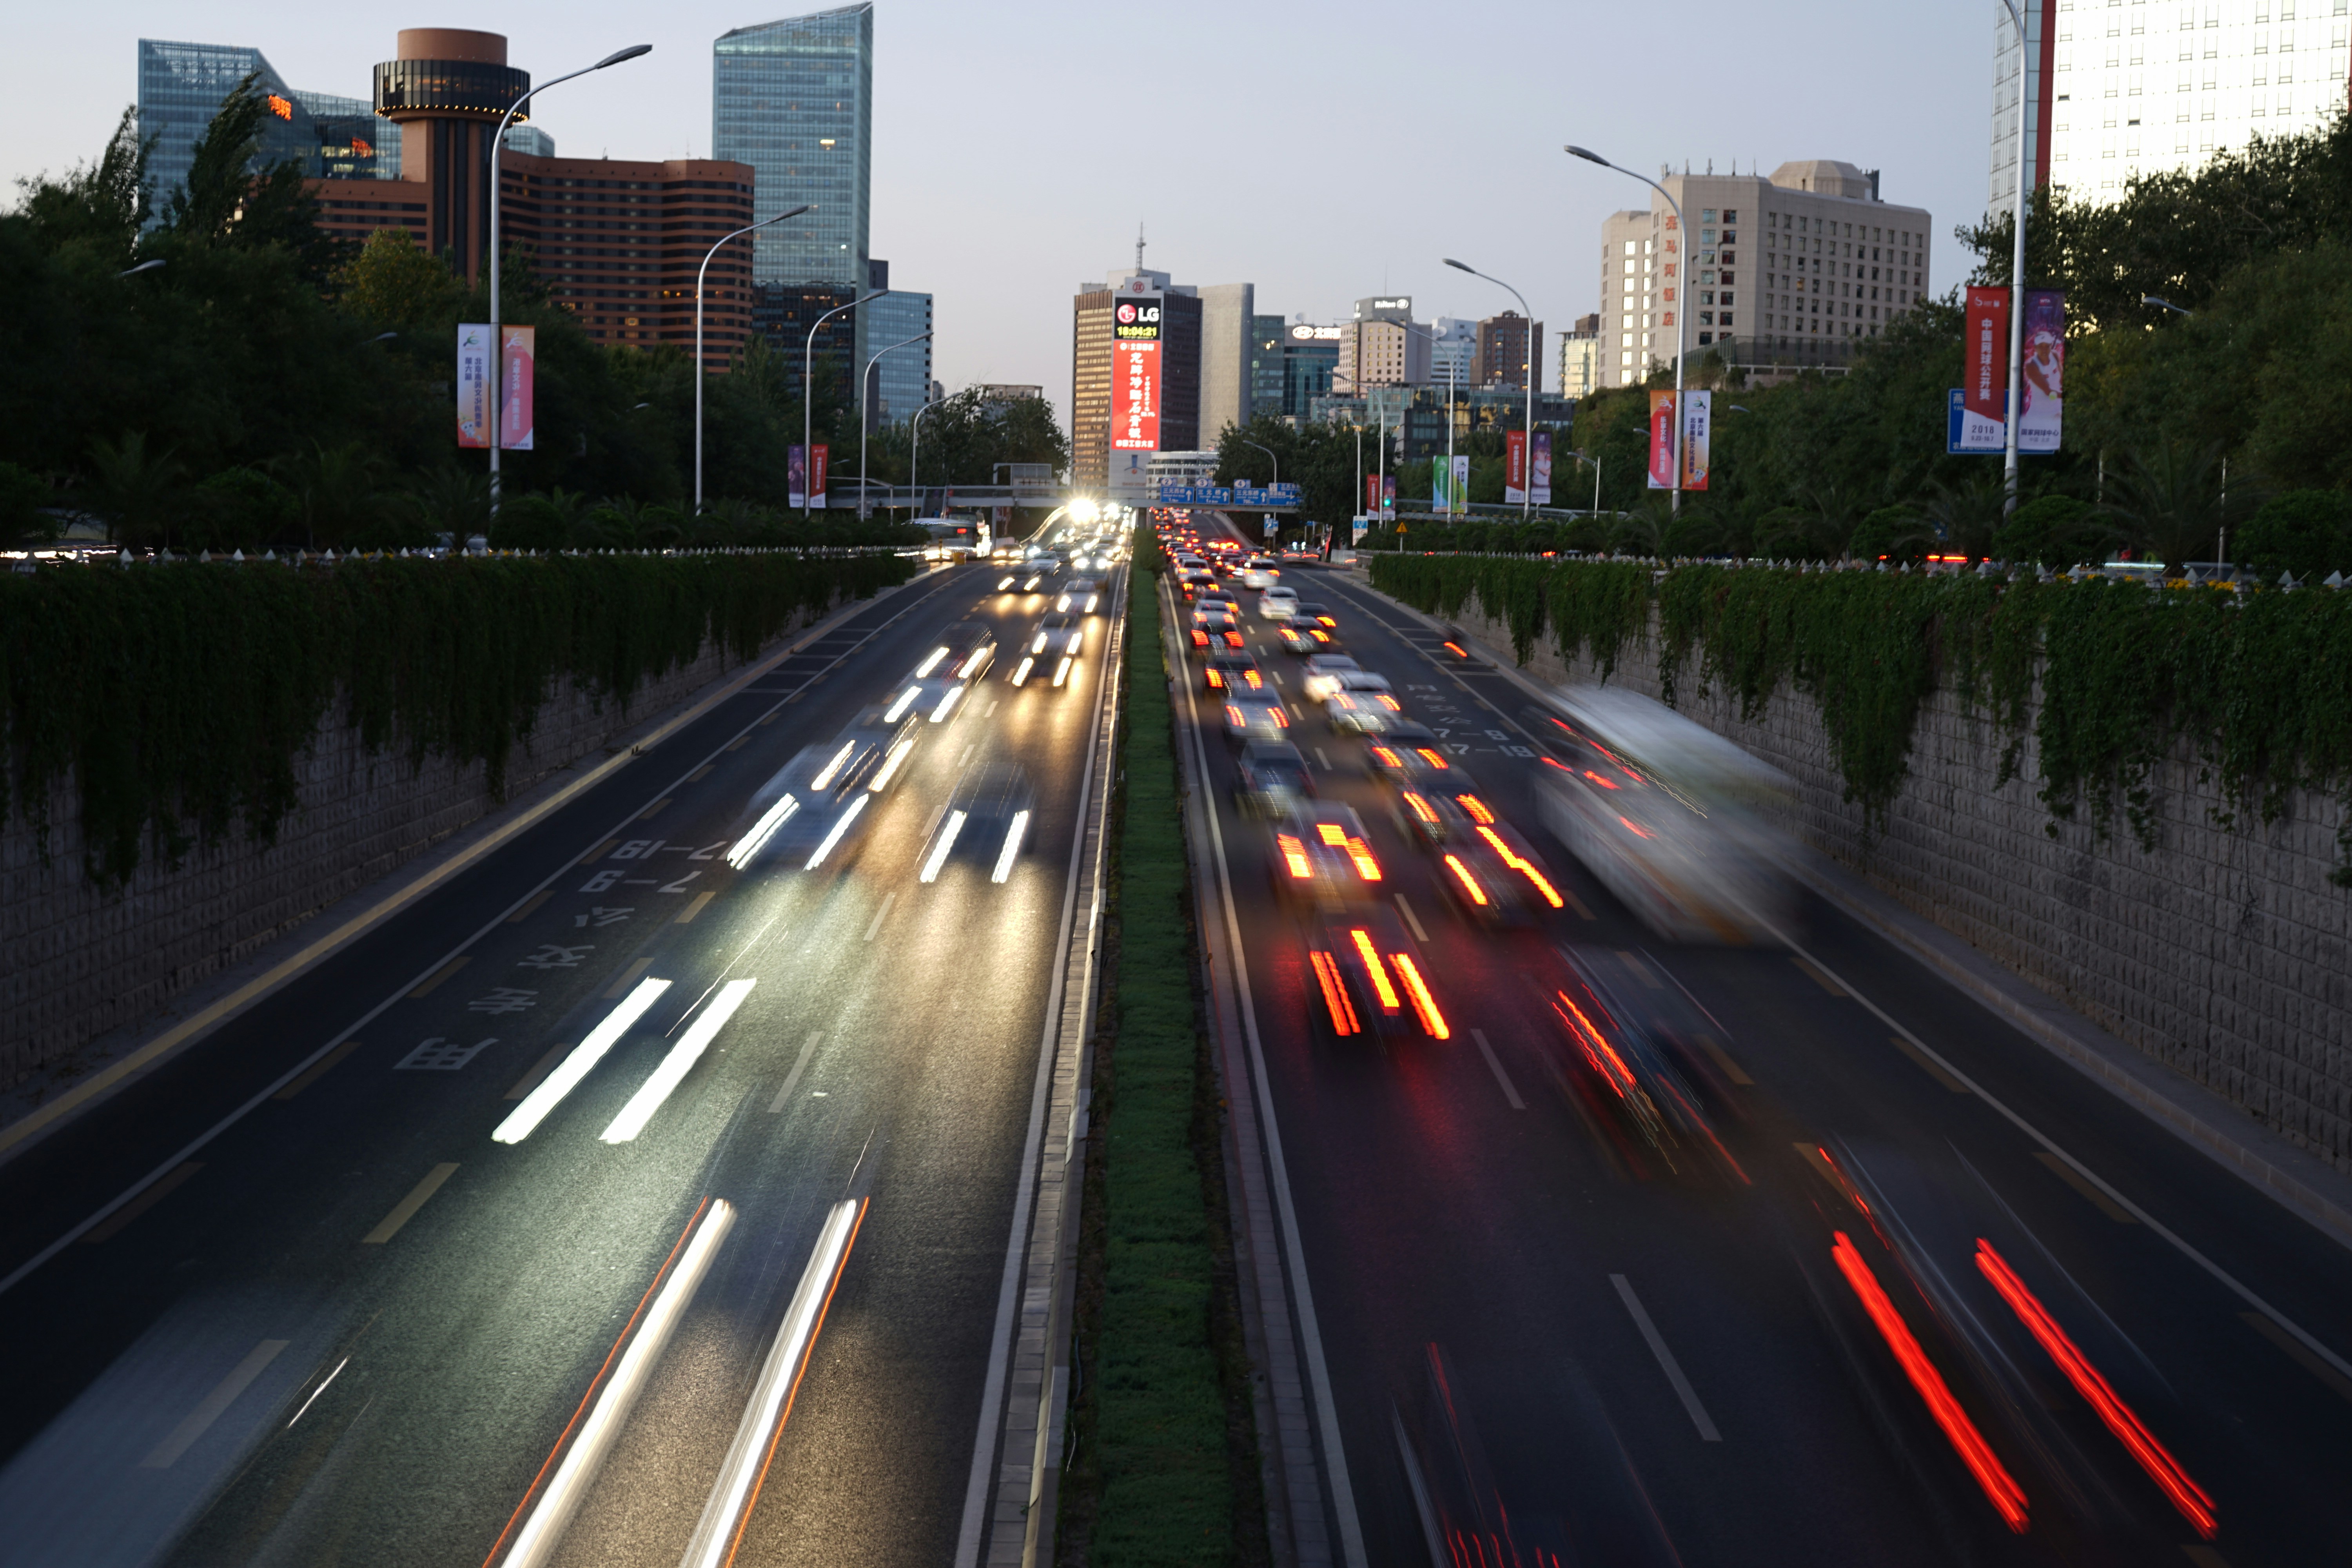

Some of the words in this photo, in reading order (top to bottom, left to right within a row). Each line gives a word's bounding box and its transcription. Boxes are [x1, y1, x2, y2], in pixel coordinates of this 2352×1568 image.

[1662, 215, 1678, 326] 亮马河饭店
[1375, 300, 1396, 309] Hilton
[1138, 307, 1159, 321] LG
[1979, 318, 1993, 401] 中国网球公开赛
[1971, 425, 1994, 434] 2018
